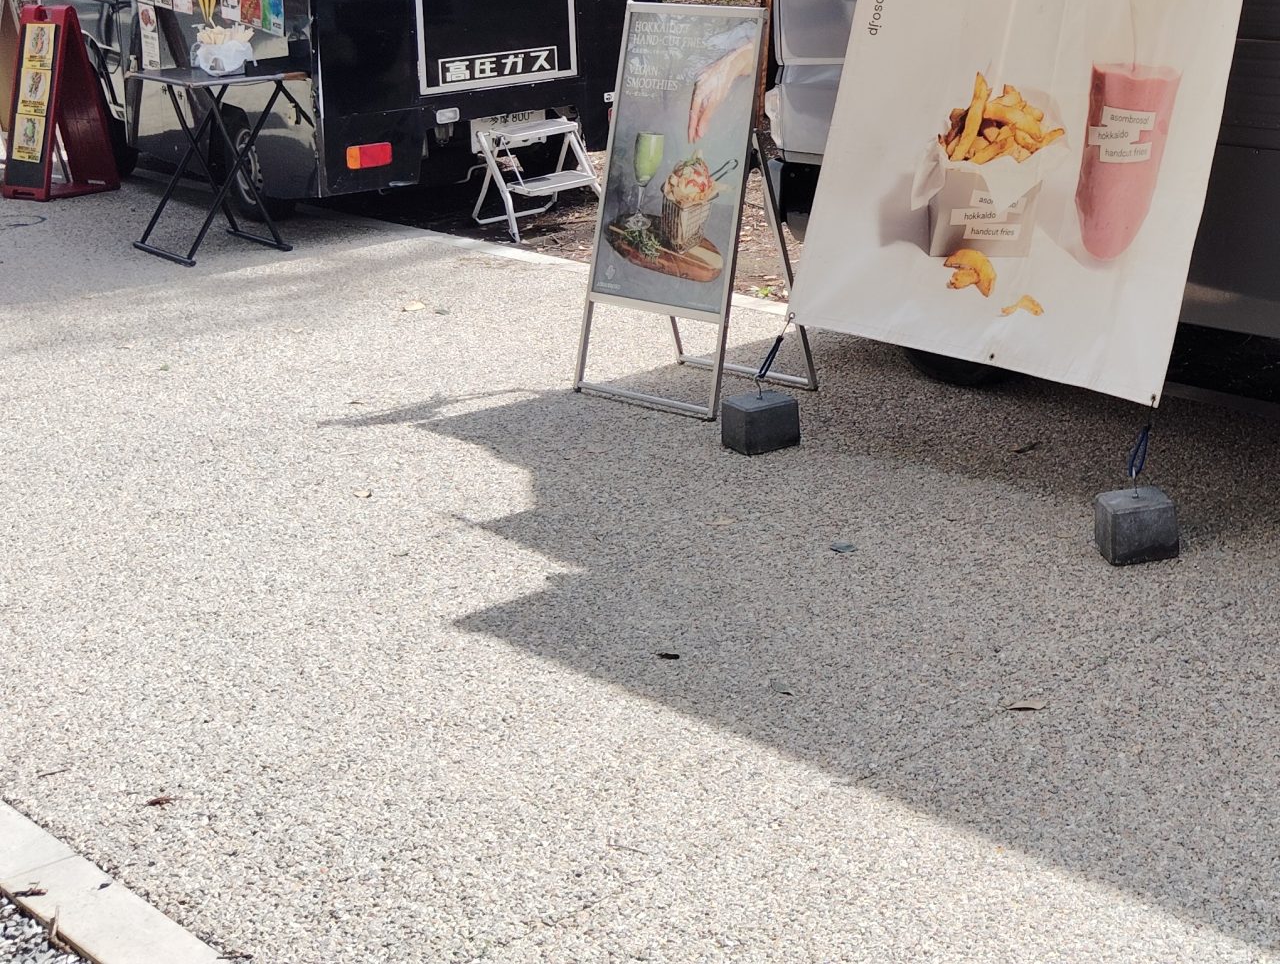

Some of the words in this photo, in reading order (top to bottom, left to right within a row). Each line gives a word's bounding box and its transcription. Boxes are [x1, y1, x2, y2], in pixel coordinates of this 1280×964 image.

[446, 50, 551, 82] 高圧ガス
[626, 77, 678, 91] SMOOTHIES
[1110, 113, 1150, 125] asombroso!
[1098, 130, 1129, 141] hokkaido
[1104, 147, 1132, 158] handcut
[1133, 147, 1148, 157] fries
[964, 212, 996, 221] hokkaido
[970, 227, 999, 236] handcut
[1000, 227, 1014, 236] fries
